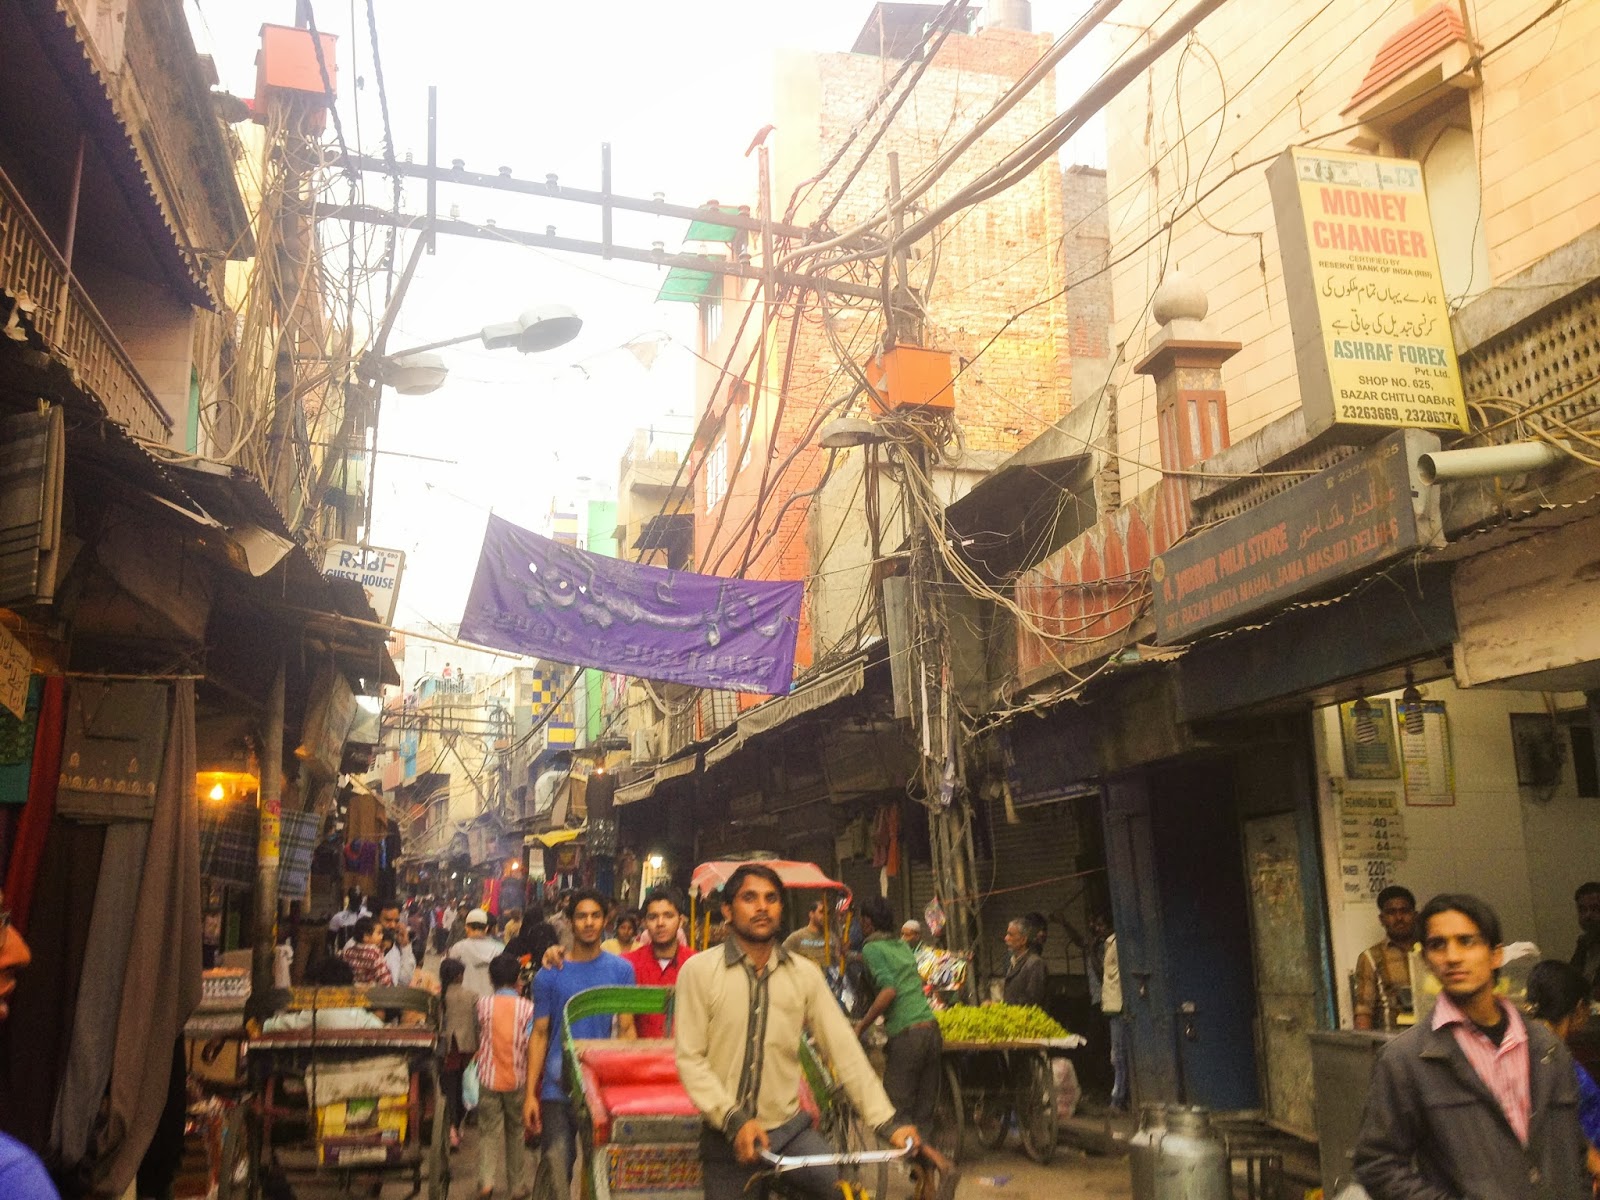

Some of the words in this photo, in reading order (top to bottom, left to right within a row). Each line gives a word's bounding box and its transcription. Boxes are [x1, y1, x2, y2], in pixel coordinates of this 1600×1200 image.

[1320, 187, 1406, 222] MONEY
[1313, 220, 1427, 258] CHANGER
[1319, 260, 1355, 270] RESERVE
[1357, 264, 1379, 273] BANK
[1380, 266, 1391, 274] OF
[1392, 267, 1413, 276] INDIA
[1414, 270, 1432, 279] (RBI)
[1349, 255, 1389, 266] CERTIFIED
[1390, 258, 1400, 266] BY
[1333, 339, 1394, 362] ASHRAF
[1398, 345, 1448, 367] FOREX
[1414, 367, 1432, 377] Pvt.
[1433, 369, 1450, 378] Ltd.
[1358, 375, 1389, 386] SHOP
[1391, 377, 1410, 388] NO.
[1412, 379, 1434, 390] 625,
[1340, 389, 1378, 401] BAZAR
[1380, 391, 1415, 403] CHITLI
[1417, 394, 1456, 407] QABAR
[1218, 542, 1247, 578] MILK
[1247, 521, 1289, 565] STORE
[361, 573, 395, 590] HOUSE
[1181, 599, 1211, 625] BAZAR
[1276, 559, 1305, 588] JAMA
[1305, 540, 1348, 575] MASJID
[1373, 817, 1387, 828] 40
[1367, 860, 1386, 877] 220
